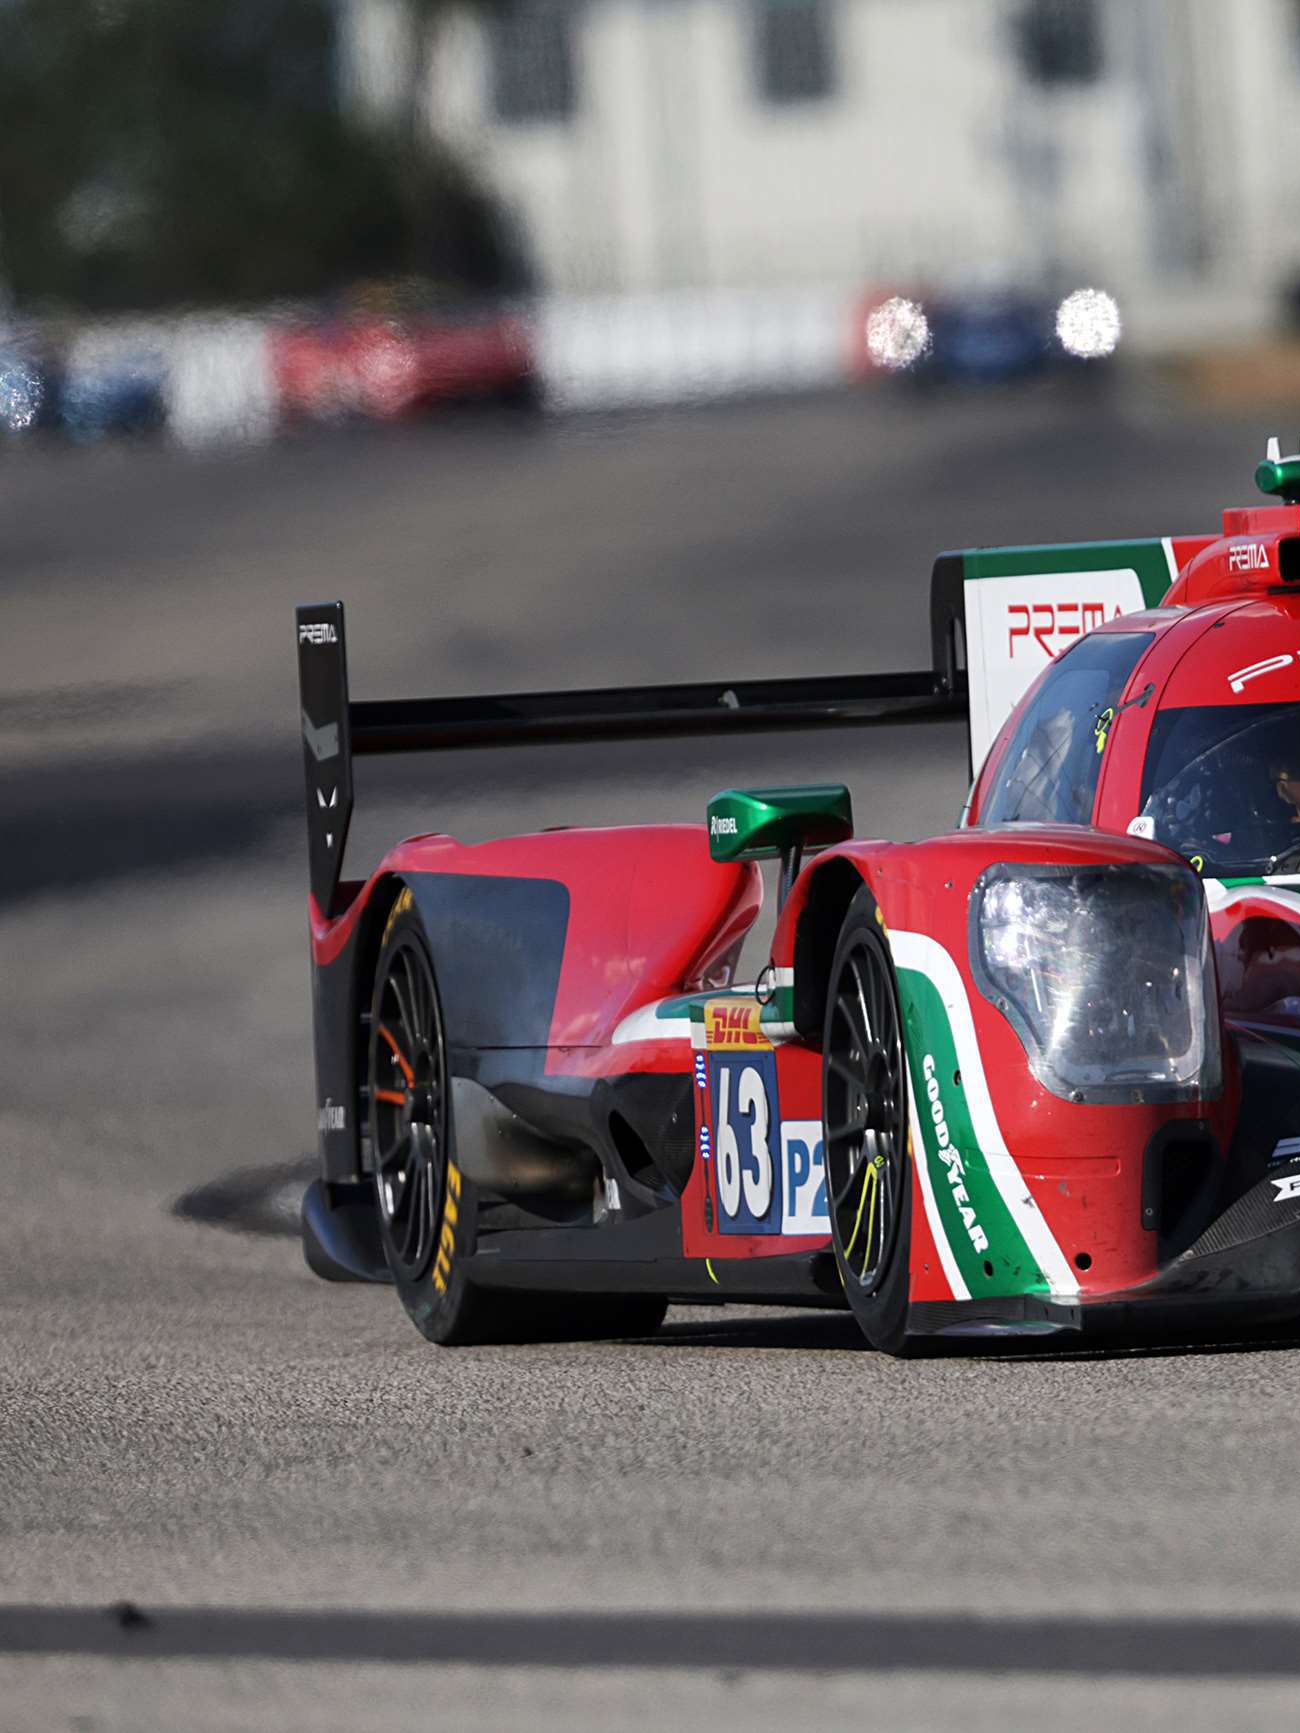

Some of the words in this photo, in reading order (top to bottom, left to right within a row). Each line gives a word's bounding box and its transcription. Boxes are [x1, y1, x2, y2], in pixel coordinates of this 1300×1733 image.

[1228, 543, 1271, 572] PREMA
[299, 623, 338, 644] PREMA
[1008, 602, 1122, 659] PREM
[713, 1008, 758, 1044] DHL
[717, 1066, 773, 1218] 63
[923, 1054, 989, 1254] GOODYEAR
[786, 1138, 829, 1217] P2
